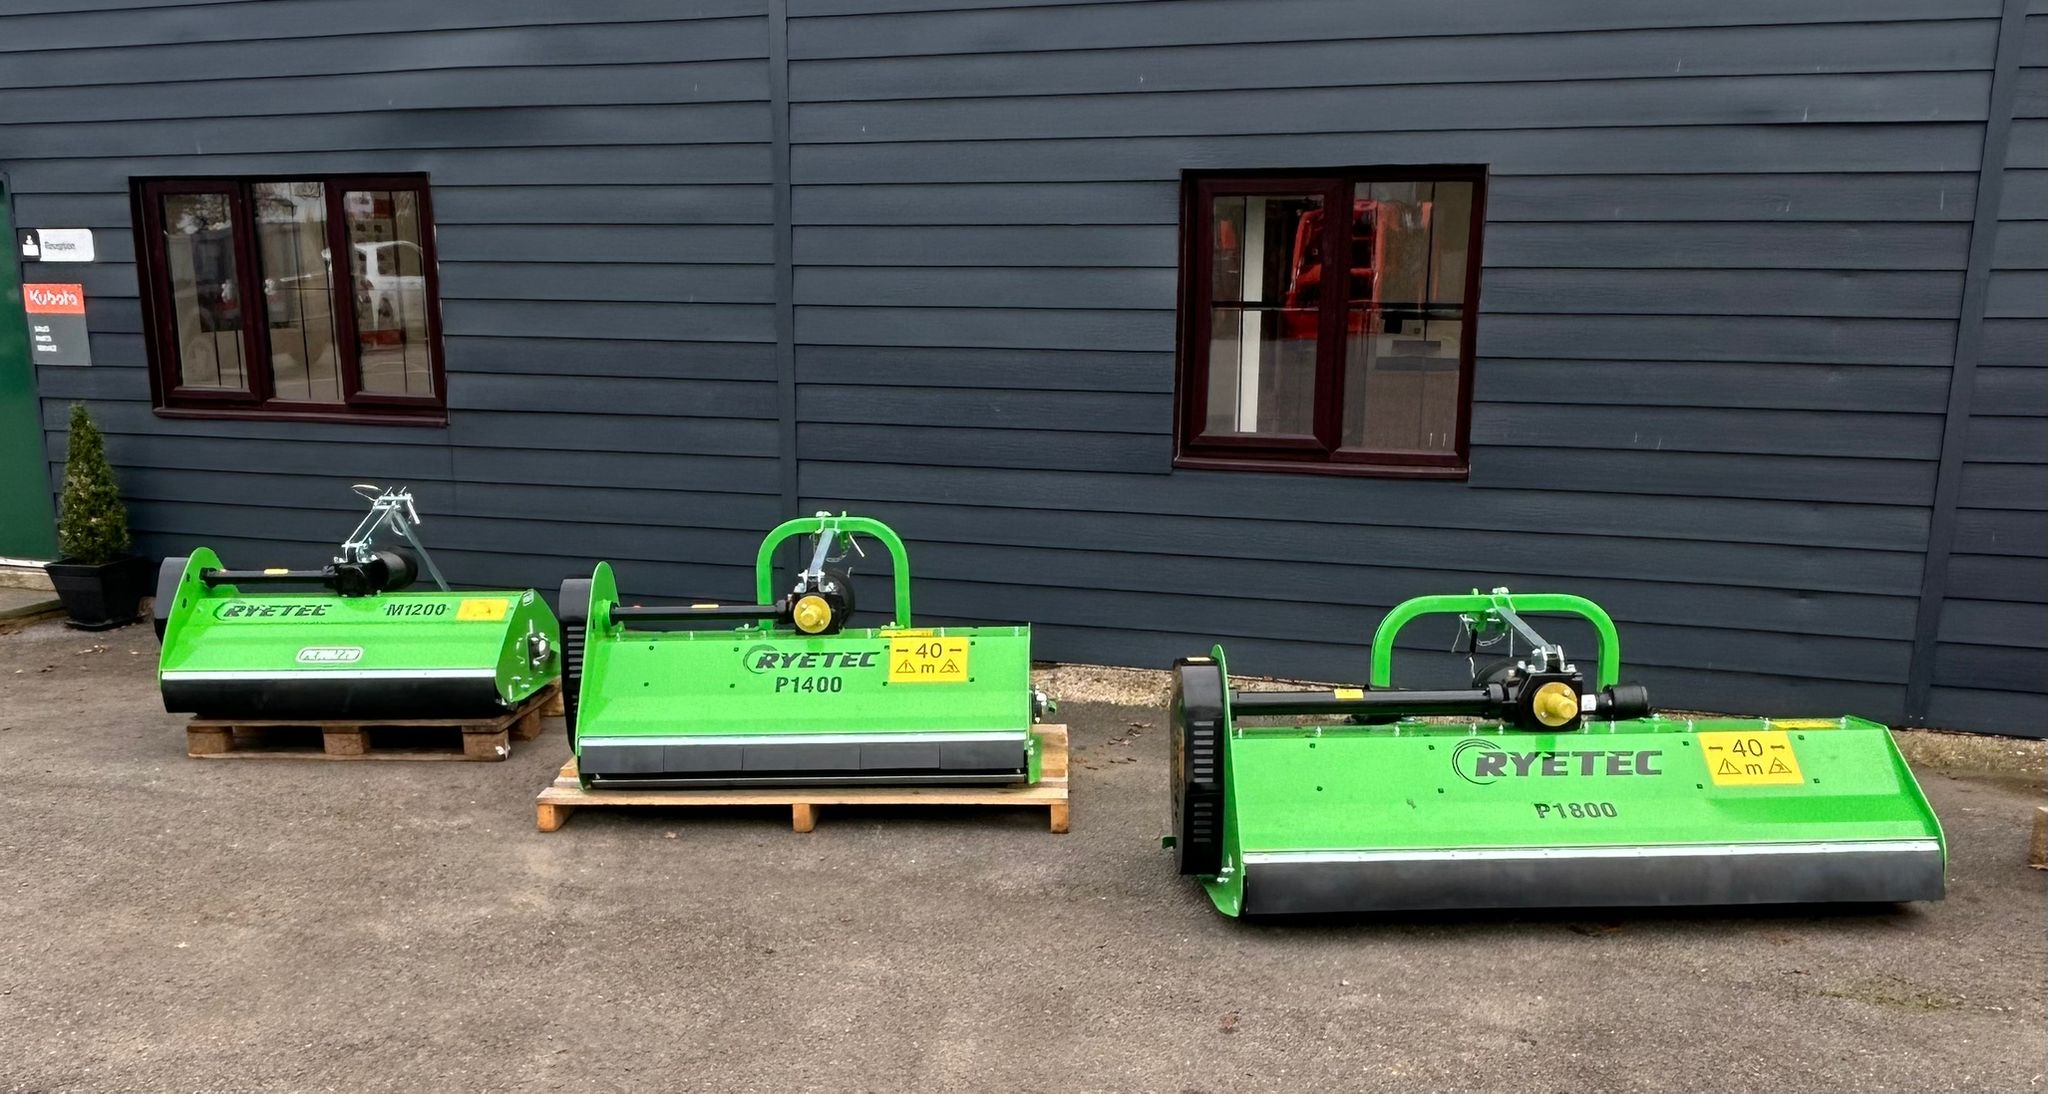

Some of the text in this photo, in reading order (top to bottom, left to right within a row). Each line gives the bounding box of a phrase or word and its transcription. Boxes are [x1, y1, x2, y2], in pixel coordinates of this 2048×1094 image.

[29, 288, 79, 306] Kubota
[222, 603, 334, 618] RYETEC
[385, 603, 447, 616] M1200
[915, 642, 943, 659] 40
[755, 651, 881, 669] RYETEC
[920, 663, 935, 674] m
[775, 676, 843, 694] P1400
[1732, 738, 1764, 758] 40
[1474, 750, 1663, 777] RYETEC
[1745, 763, 1763, 775] m
[1533, 802, 1618, 819] P1800
